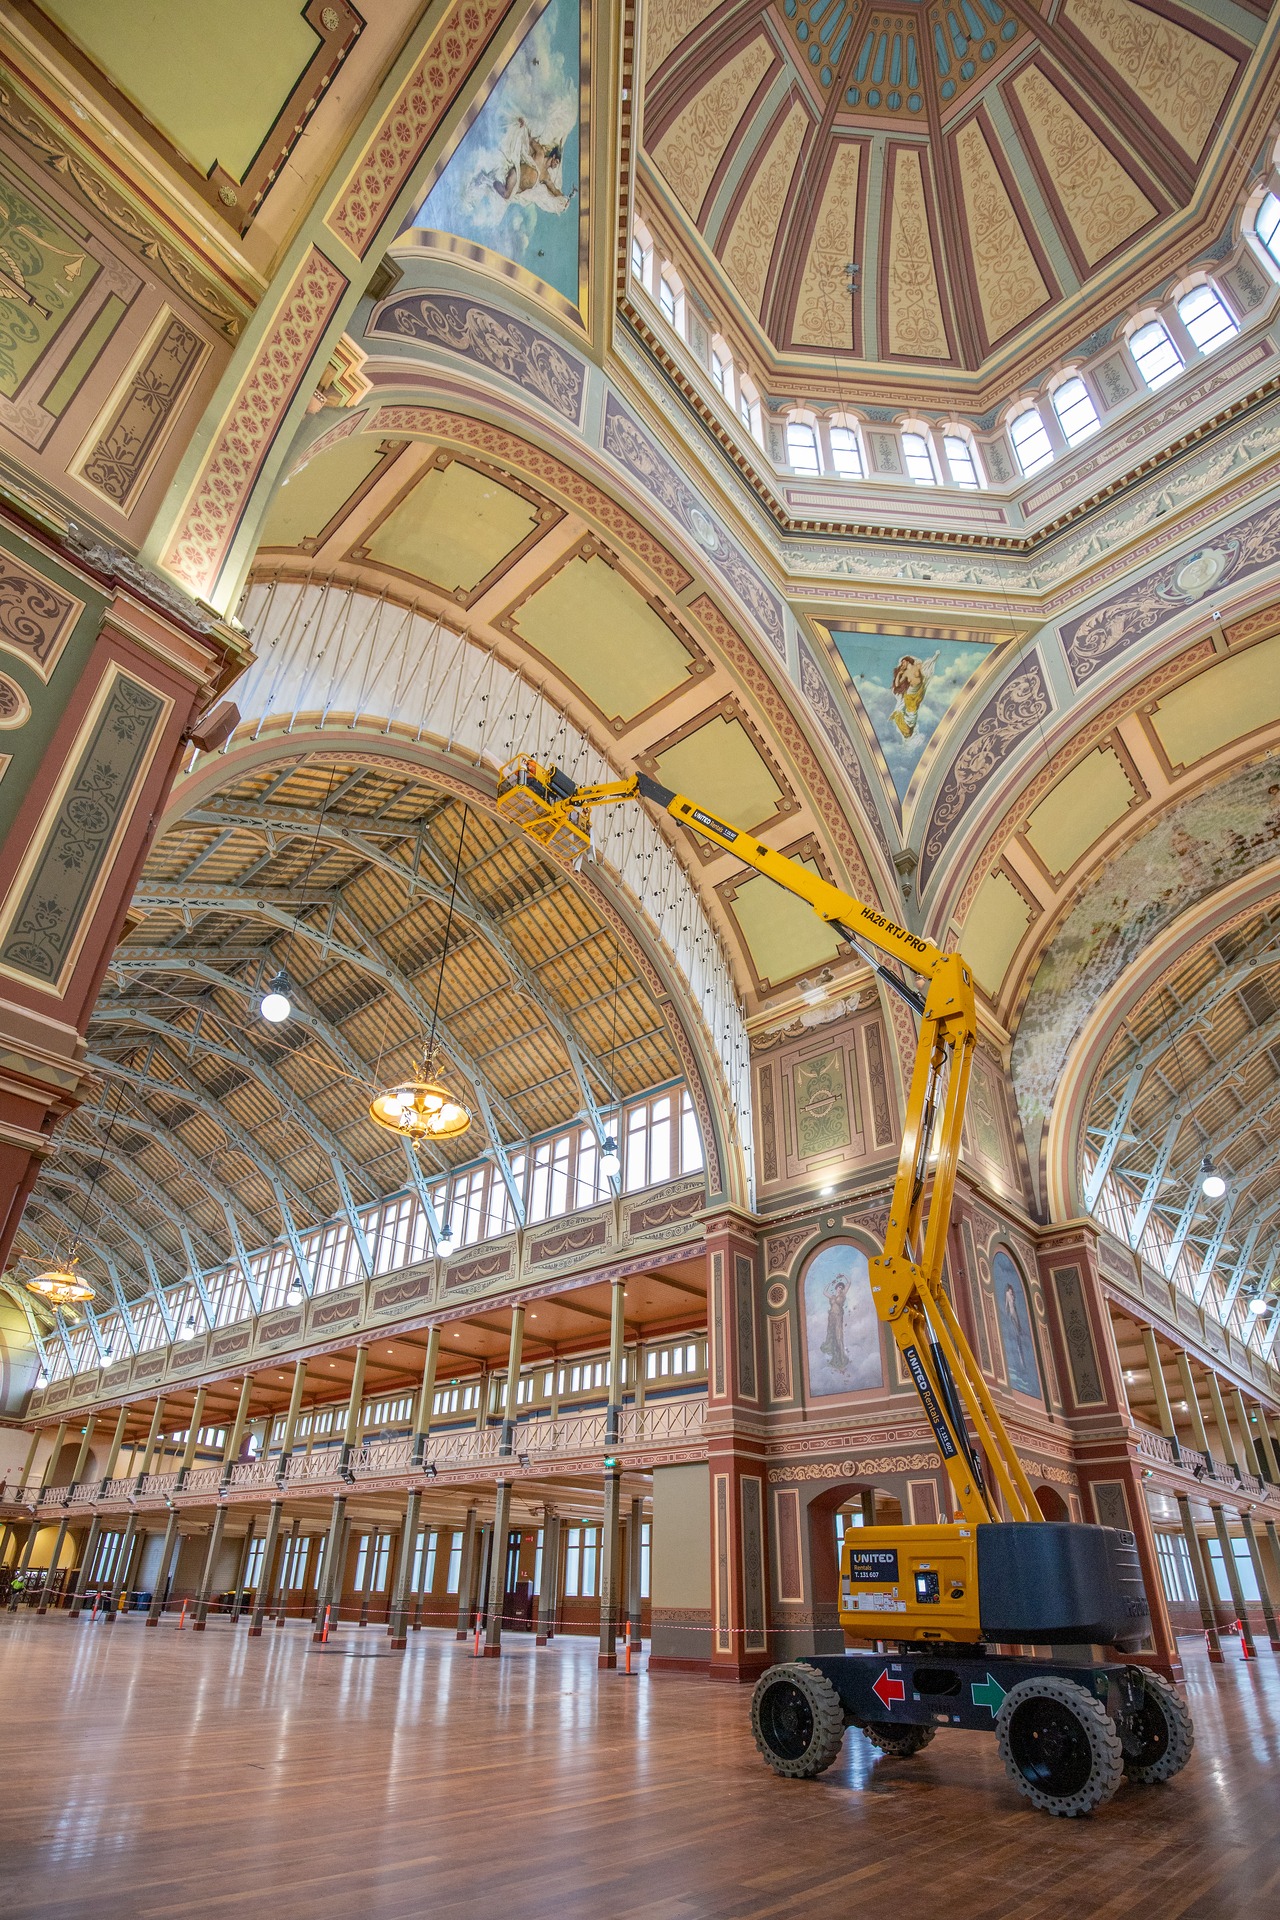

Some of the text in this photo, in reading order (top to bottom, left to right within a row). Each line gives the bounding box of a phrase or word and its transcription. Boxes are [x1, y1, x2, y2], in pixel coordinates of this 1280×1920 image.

[1060, 376, 1228, 489] DEI GRATIA
[694, 811, 723, 833] UNITED Rentals
[860, 907, 927, 953] HA26 RTJ PRO
[907, 1350, 928, 1390] UNITED
[922, 1391, 940, 1424] Rentals
[853, 1553, 894, 1563] UNITED
